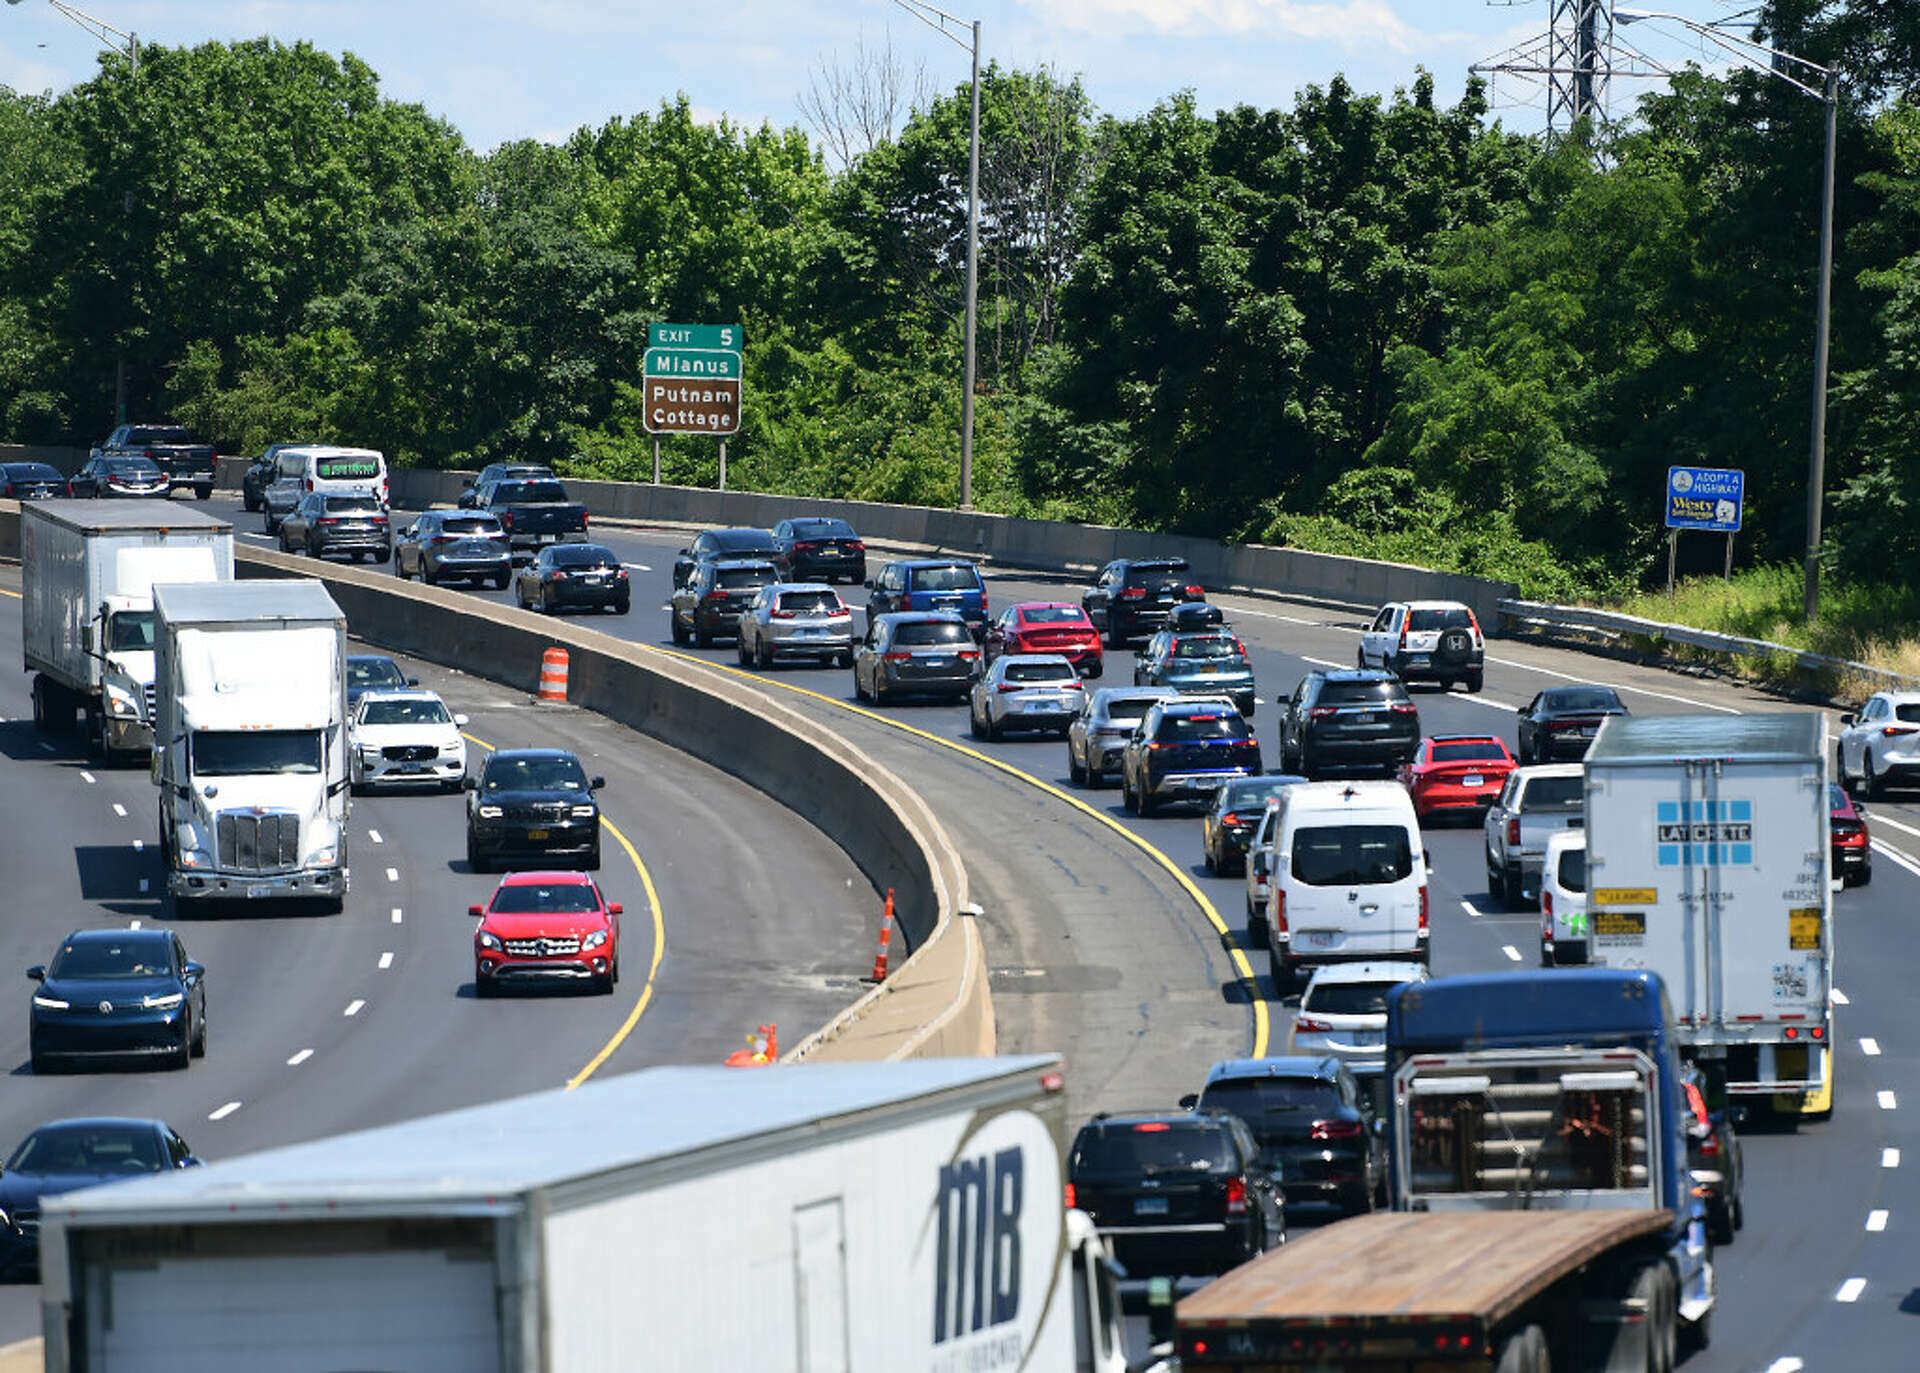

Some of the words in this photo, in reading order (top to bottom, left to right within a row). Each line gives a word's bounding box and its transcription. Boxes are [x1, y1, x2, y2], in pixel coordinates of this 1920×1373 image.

[658, 328, 692, 342] EXIT
[720, 328, 733, 346] 5
[657, 356, 729, 373] Mianus
[653, 386, 731, 403] Putnam
[653, 408, 731, 430] Cottage
[1696, 472, 1729, 483] ADOPT
[1732, 475, 1739, 484] A
[1660, 825, 1749, 841] LATCRETE
